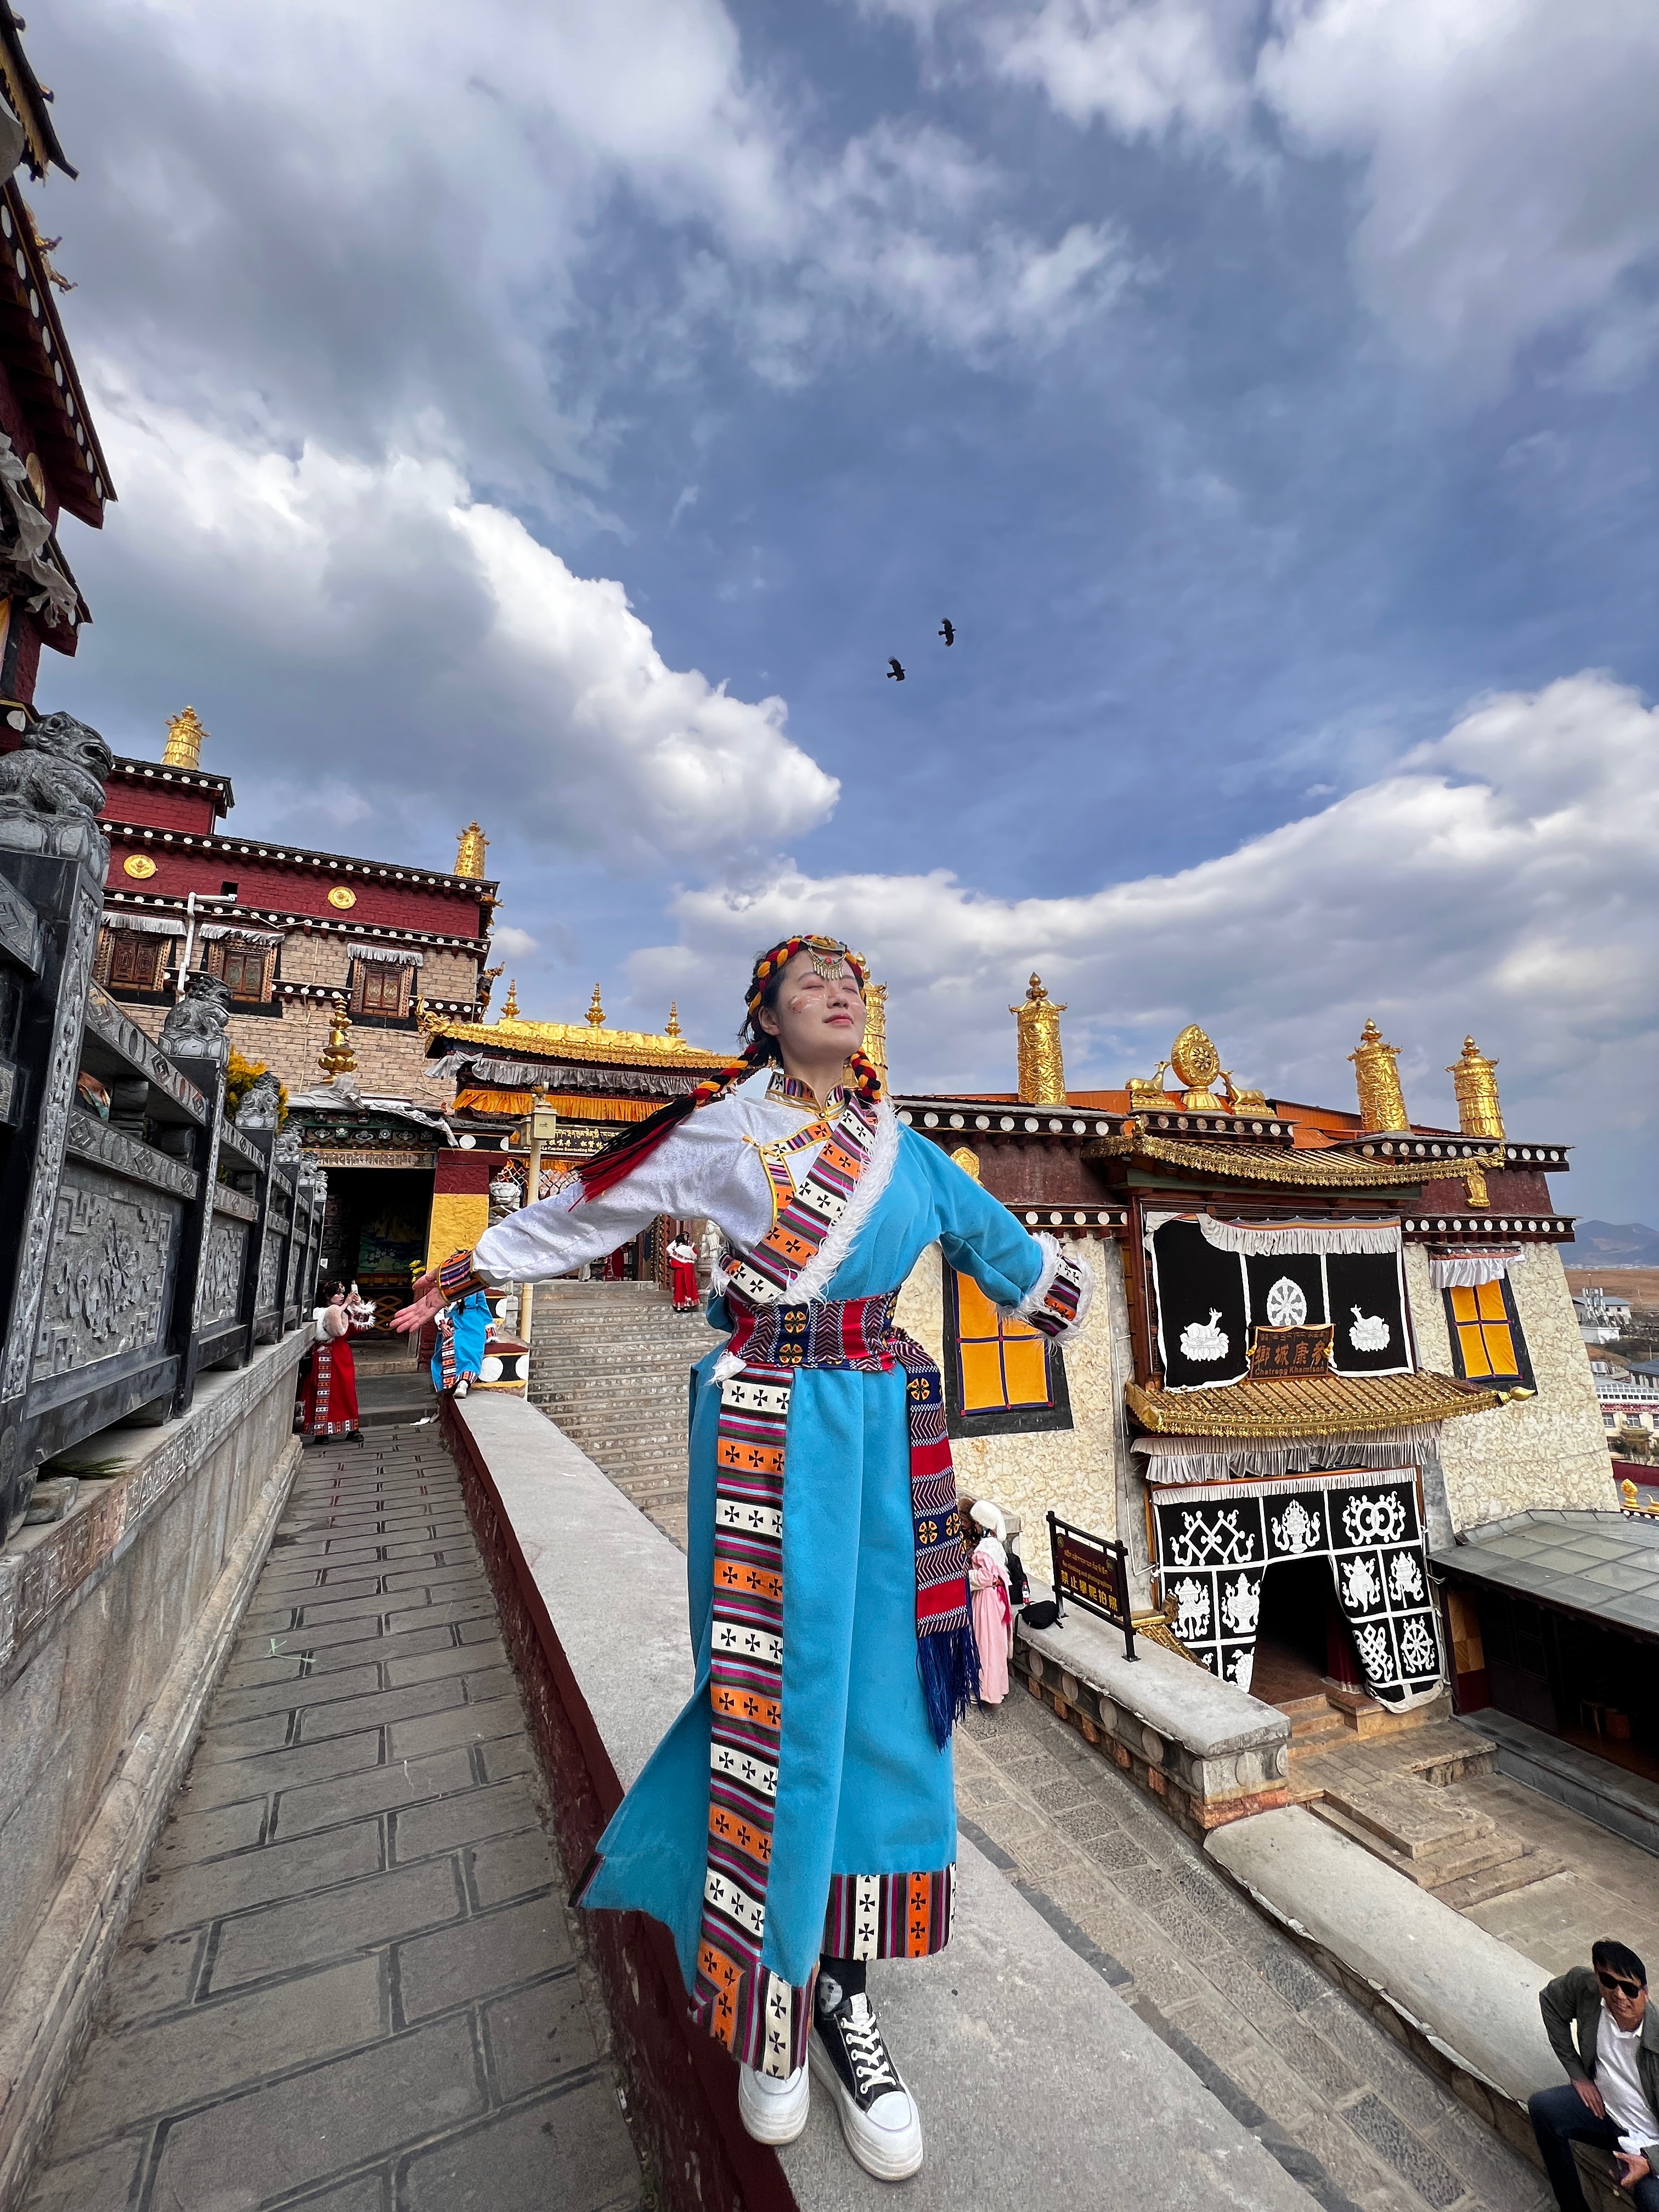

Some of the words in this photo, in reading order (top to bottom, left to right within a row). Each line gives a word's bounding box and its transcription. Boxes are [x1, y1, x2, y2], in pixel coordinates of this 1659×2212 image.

[1061, 1570, 1118, 1612] 禁止攀爬拍照
